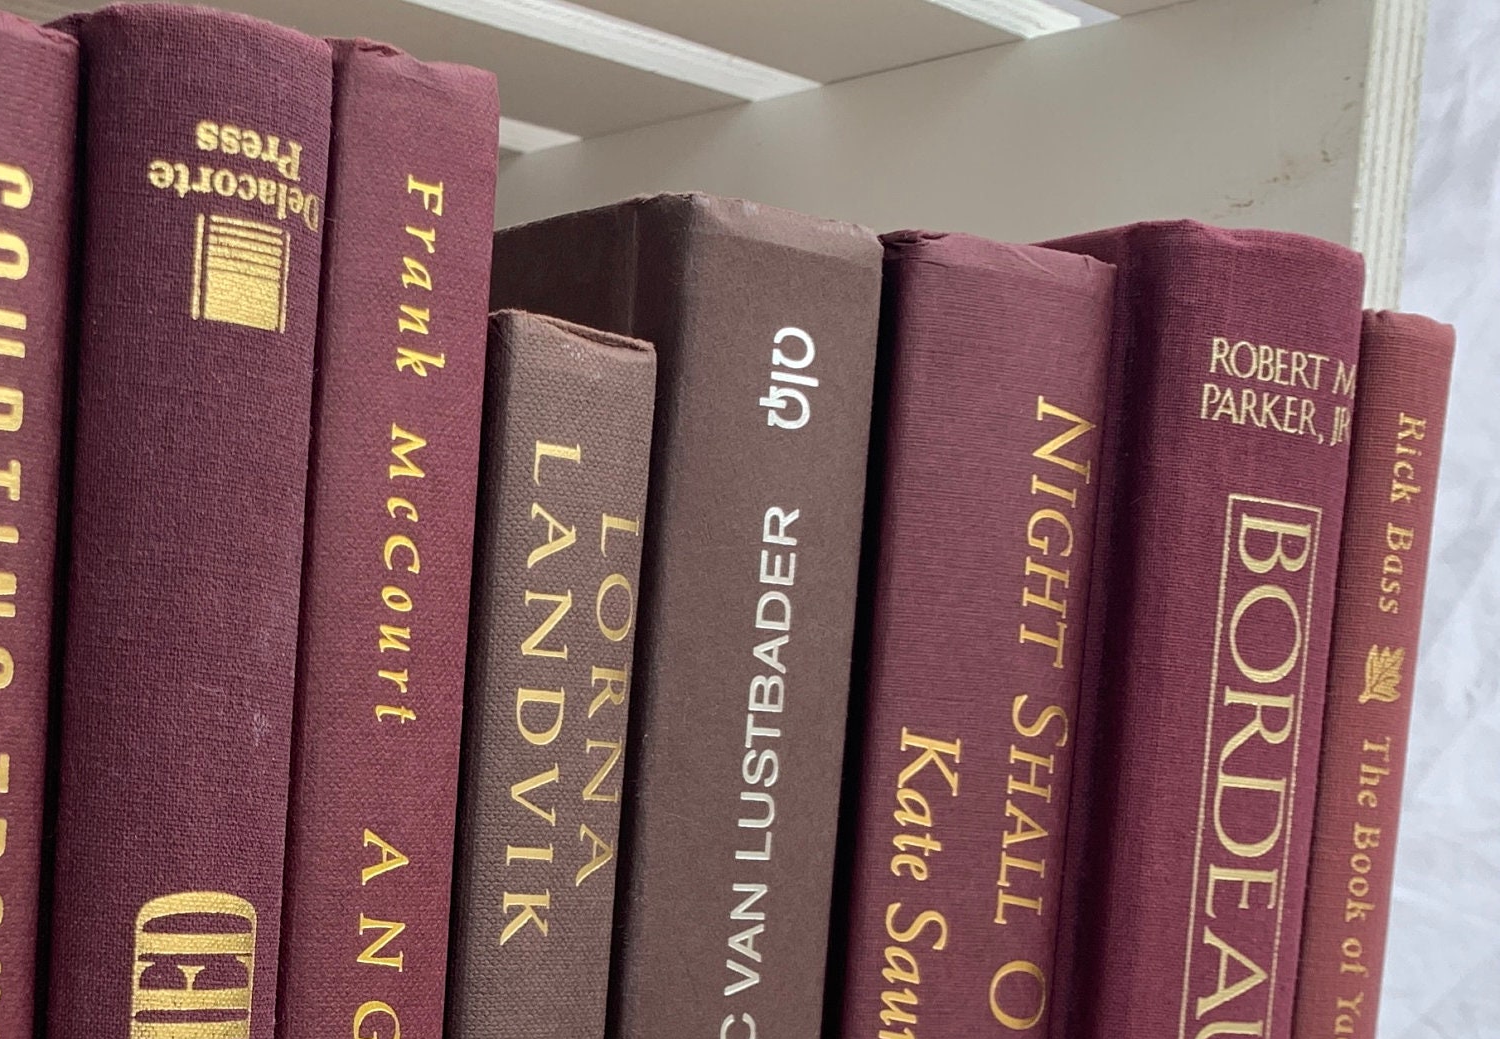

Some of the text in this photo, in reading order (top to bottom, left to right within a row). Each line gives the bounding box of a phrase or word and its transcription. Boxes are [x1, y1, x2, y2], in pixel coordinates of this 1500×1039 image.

[148, 159, 320, 233] Delacorte
[195, 120, 304, 182] Press
[1201, 383, 1324, 444] PARKER,
[1209, 337, 1329, 391] ROBERT
[375, 174, 445, 725] Frank McCourt
[1390, 412, 1428, 503] Rick
[1019, 396, 1096, 668] NIGHT
[1379, 523, 1414, 614] Bass
[500, 440, 581, 946] LANDVIK
[576, 512, 639, 887] LORNA
[735, 506, 800, 861] LUSTBADER
[890, 727, 961, 882] Kate
[994, 694, 1069, 925] SHALL
[1357, 736, 1391, 808] The
[1345, 822, 1381, 922] Book
[723, 883, 768, 997] VAN
[1340, 937, 1369, 977] of
